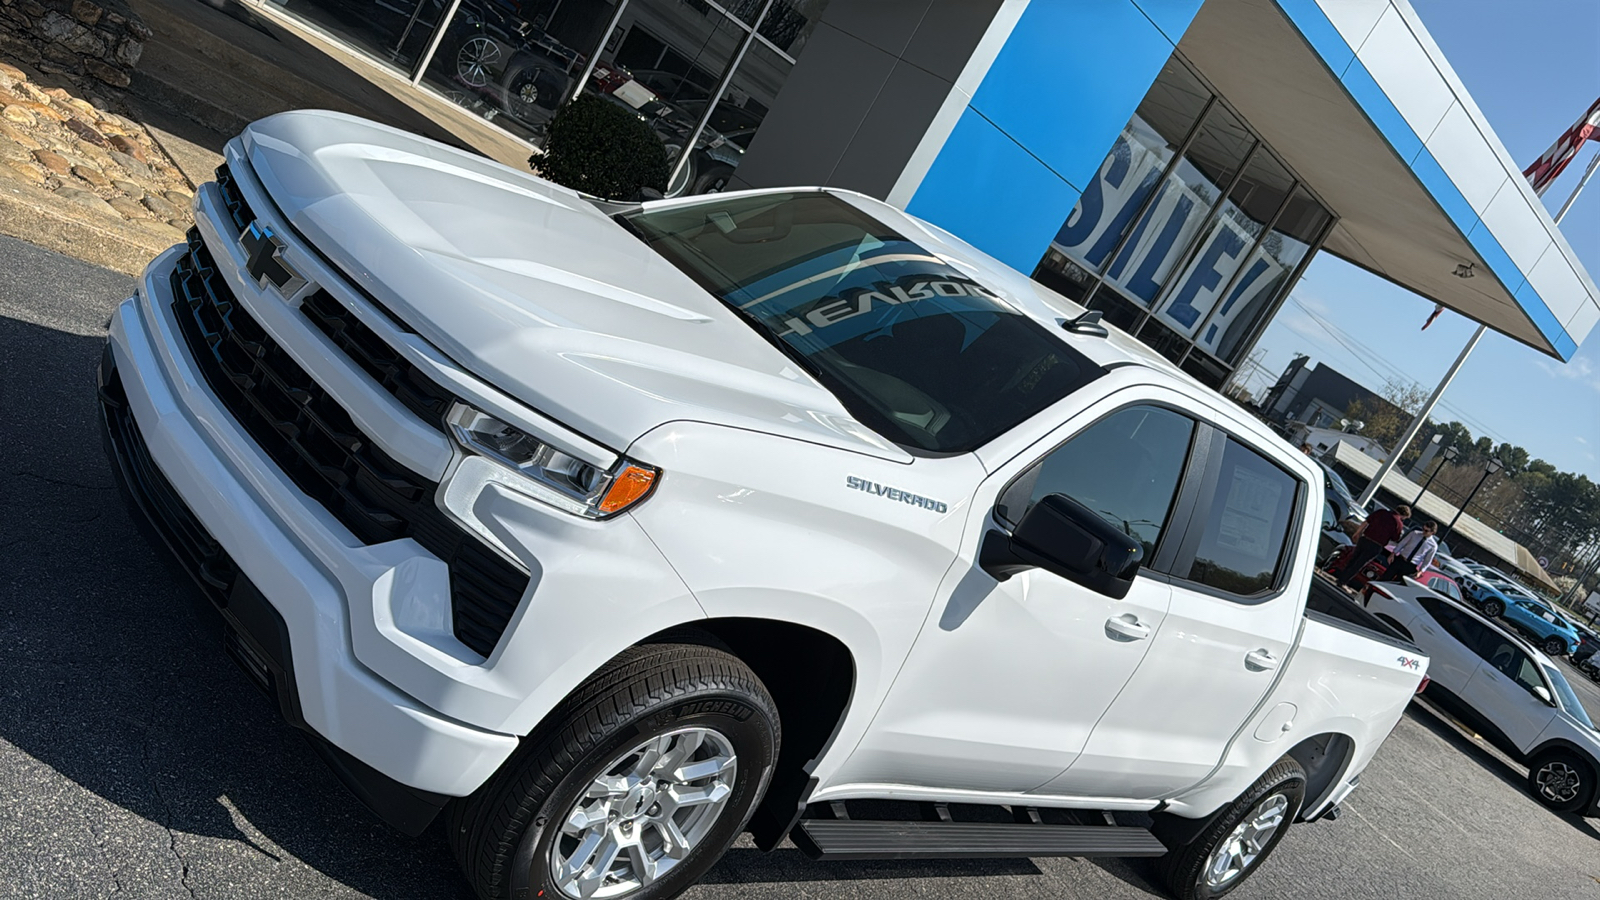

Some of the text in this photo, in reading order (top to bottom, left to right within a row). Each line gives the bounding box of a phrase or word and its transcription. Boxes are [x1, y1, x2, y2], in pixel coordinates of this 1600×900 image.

[1053, 134, 1271, 346] SALE!
[846, 475, 948, 514] SILVERADO
[680, 701, 752, 720] MICHELIN
